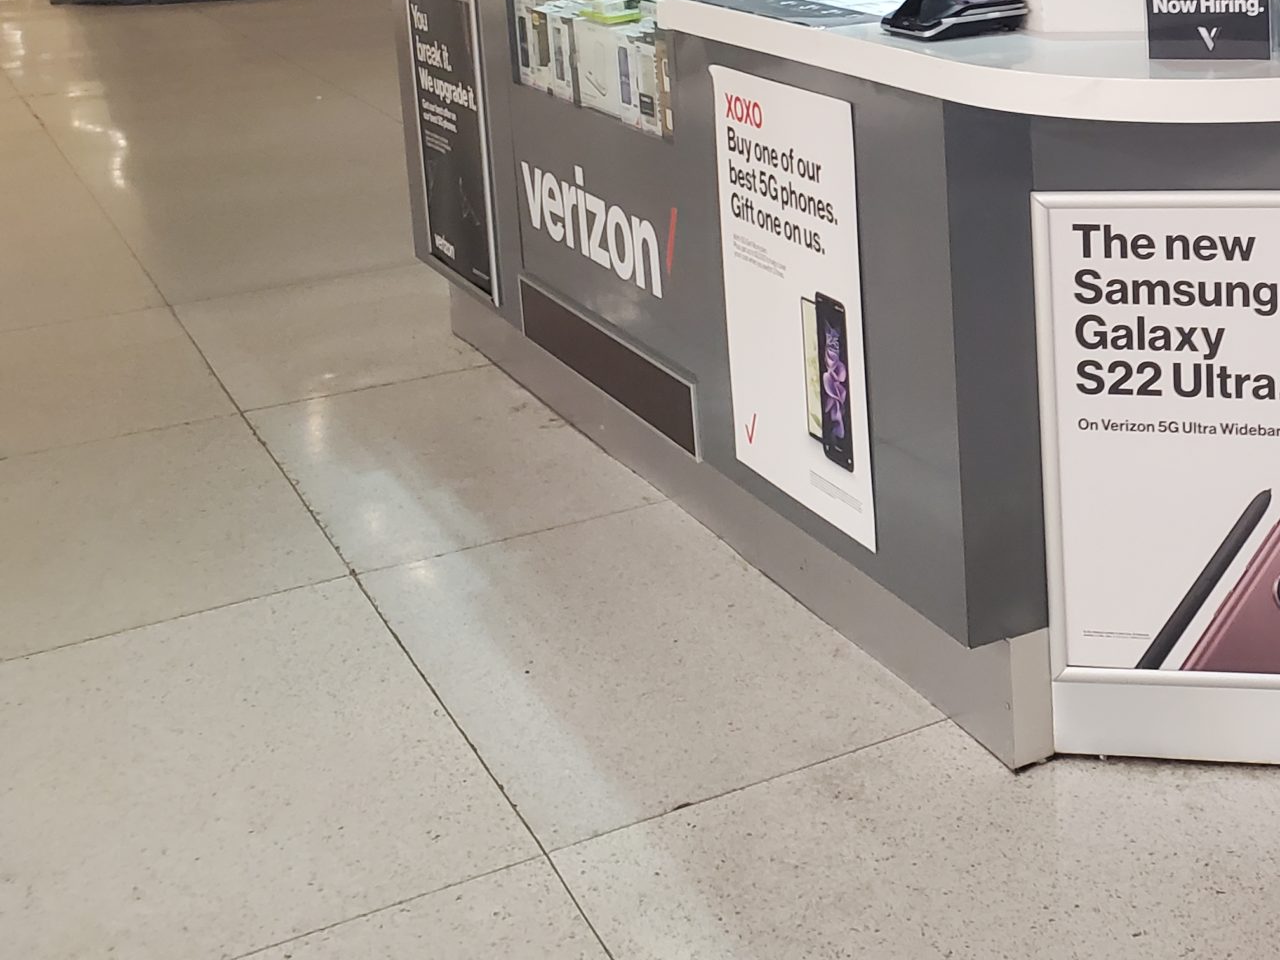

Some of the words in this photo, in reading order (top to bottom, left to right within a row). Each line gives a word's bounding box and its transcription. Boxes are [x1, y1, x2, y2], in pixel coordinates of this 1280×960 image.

[410, 4, 428, 32] You
[415, 35, 442, 68] break
[441, 44, 453, 72] it.
[418, 66, 434, 93] We
[433, 77, 469, 107] upgrade
[467, 85, 478, 112] it.
[725, 93, 762, 128] XOXO
[727, 126, 752, 163] Buy
[754, 141, 778, 168] one
[781, 148, 794, 175] of
[797, 156, 822, 183] our
[729, 159, 757, 194] best
[759, 170, 778, 201] 5G
[781, 181, 838, 225] phones.
[521, 161, 663, 299] verizon
[731, 192, 755, 225] Gift
[757, 208, 781, 236] one
[784, 220, 801, 245] on
[804, 227, 826, 255] us.
[1072, 224, 1156, 259] The
[1165, 234, 1256, 261] new
[434, 233, 456, 260] verizon
[1074, 269, 1278, 316] Samsung
[1075, 314, 1226, 360] Galaxy
[1076, 360, 1162, 396] S22
[1078, 418, 1099, 431] On
[1101, 419, 1155, 434] Verizon
[1158, 421, 1179, 433] 5G
[1182, 422, 1217, 435] Ultra
